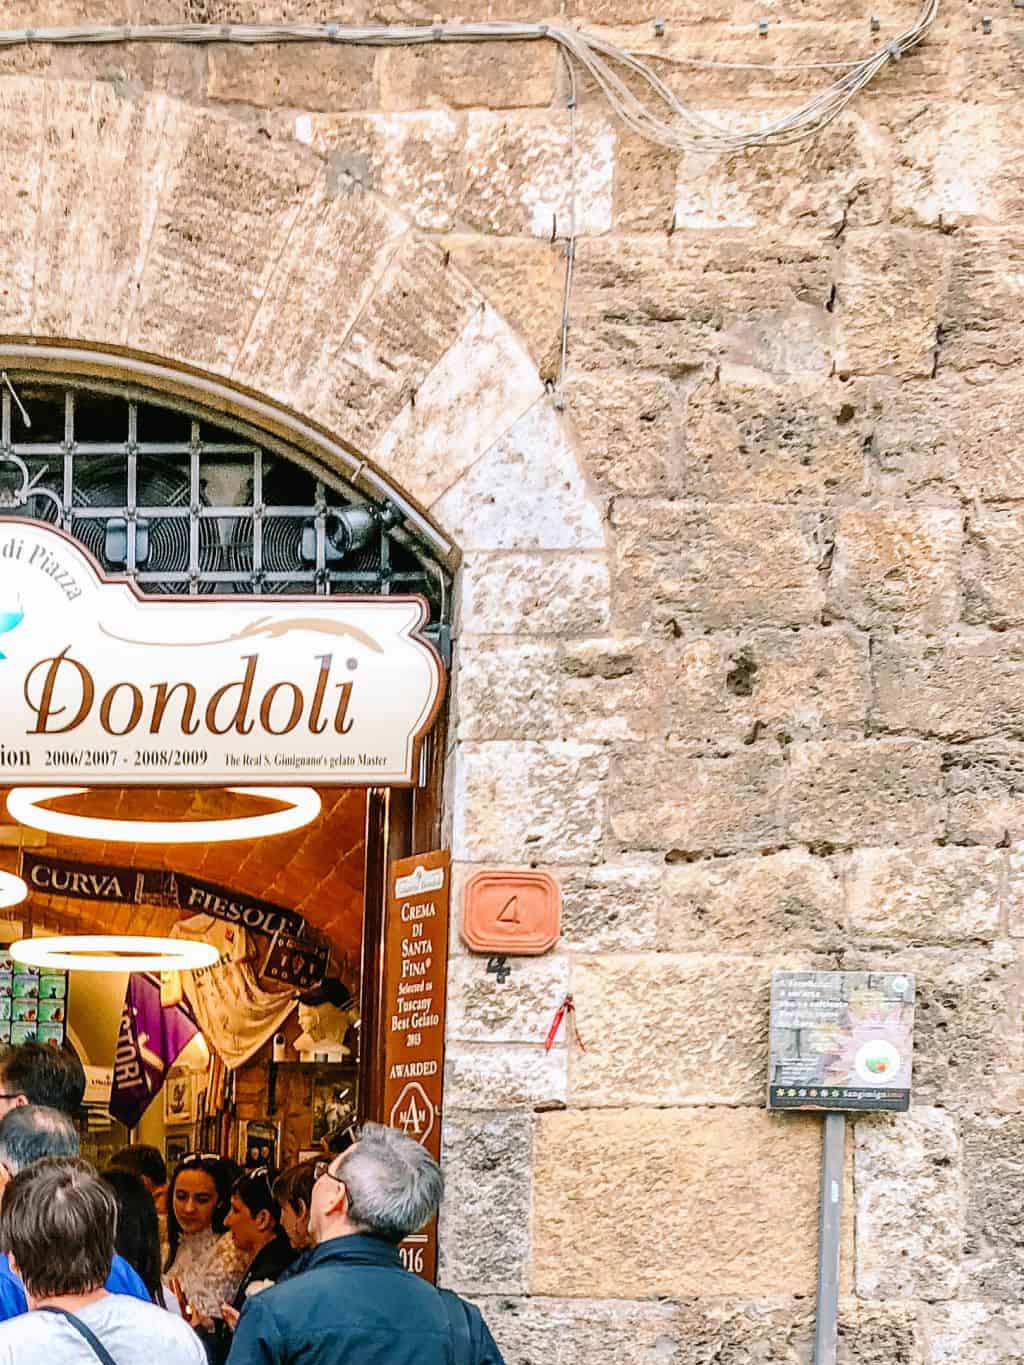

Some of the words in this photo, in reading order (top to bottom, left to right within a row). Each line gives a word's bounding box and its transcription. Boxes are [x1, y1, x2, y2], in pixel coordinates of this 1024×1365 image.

[2, 538, 25, 560] di
[28, 544, 82, 600] Piazza
[24, 644, 358, 736] Dondoli
[45, 750, 118, 766] 2006/2007
[134, 750, 208, 766] 2008/2009
[225, 753, 240, 766] The
[243, 753, 262, 766] Real
[330, 753, 355, 768] gelato
[358, 753, 388, 766] Master
[31, 863, 123, 898] CURVA
[412, 922, 423, 937] DI
[397, 997, 433, 1014] Tuscany
[391, 1015, 410, 1031] Best
[411, 1011, 439, 1029] Gelato
[390, 1061, 437, 1079] AWARDED
